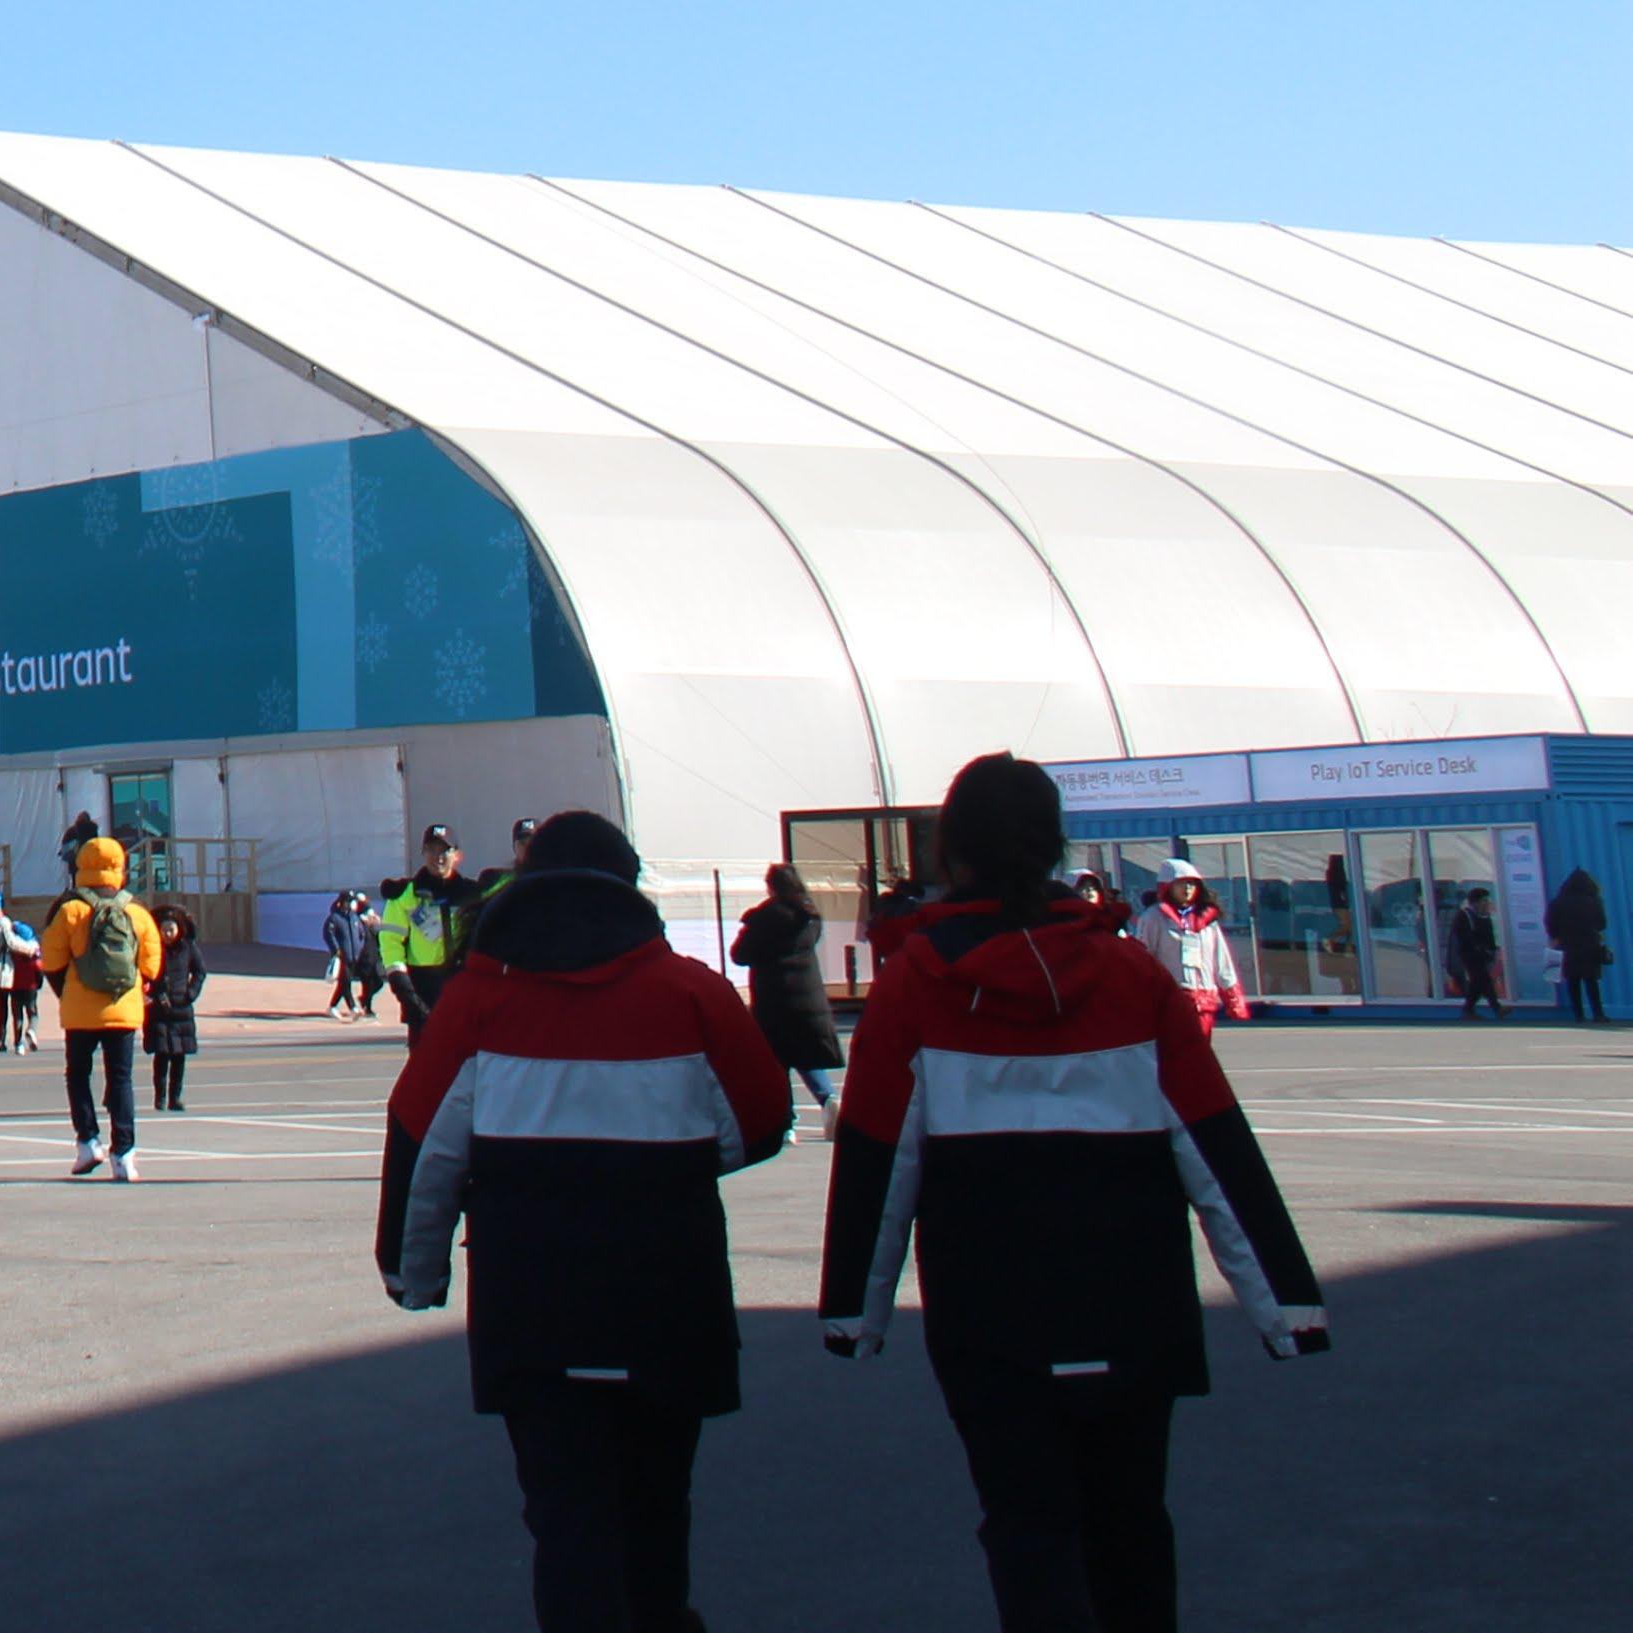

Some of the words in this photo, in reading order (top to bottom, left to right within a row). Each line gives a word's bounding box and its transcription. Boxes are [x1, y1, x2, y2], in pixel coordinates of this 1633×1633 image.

[1310, 764, 1342, 783] Play
[1376, 759, 1433, 778] Service
[1438, 755, 1477, 775] Desk
